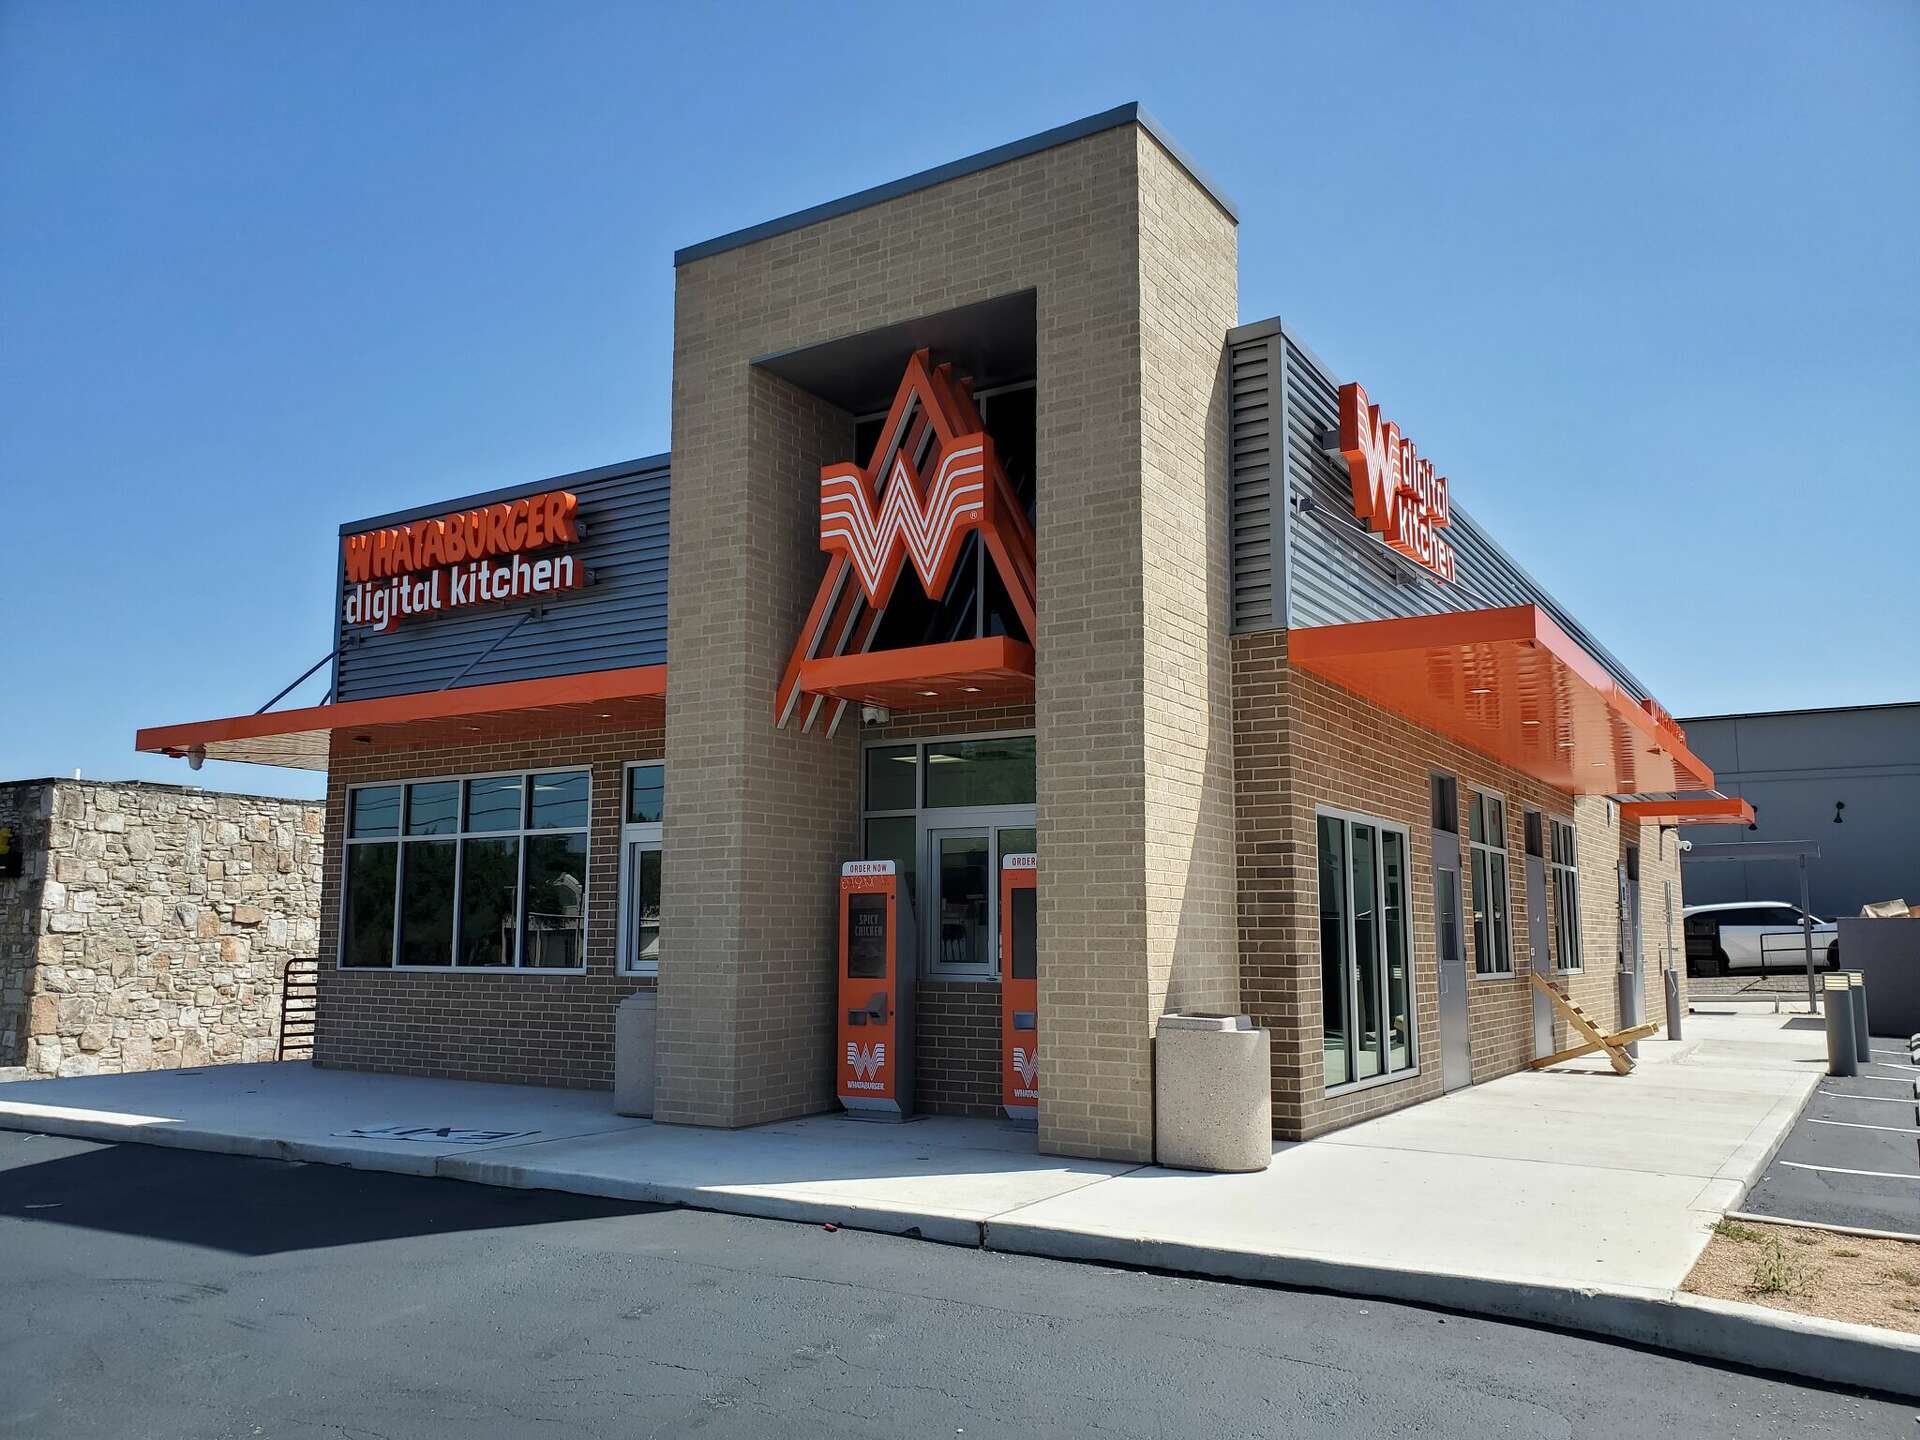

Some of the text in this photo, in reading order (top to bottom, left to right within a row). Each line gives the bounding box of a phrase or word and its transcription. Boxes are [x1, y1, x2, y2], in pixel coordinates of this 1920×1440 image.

[1401, 437, 1451, 526] digital
[345, 491, 577, 582] WHATABURGER
[1399, 495, 1457, 583] kitchen
[346, 554, 574, 632] digital kitchen
[849, 863, 888, 873] ORDER NOW
[1011, 857, 1036, 866] ORDER
